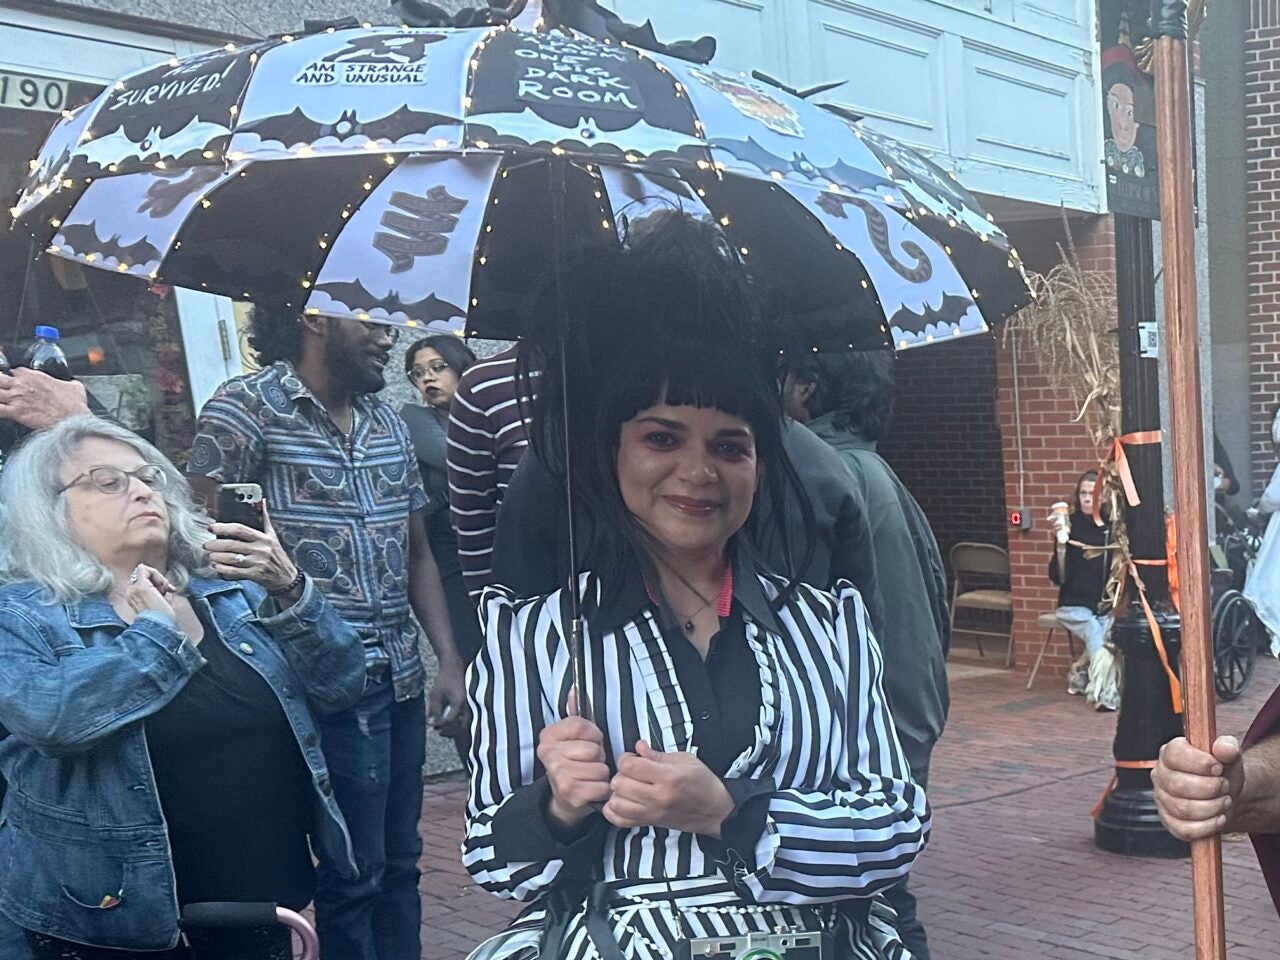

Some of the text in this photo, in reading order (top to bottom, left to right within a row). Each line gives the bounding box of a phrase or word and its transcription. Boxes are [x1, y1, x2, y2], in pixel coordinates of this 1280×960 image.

[514, 49, 591, 64] ONE
[305, 62, 427, 73] AM STRANGE
[552, 62, 611, 78] BIG
[109, 58, 238, 110] SURVIVED!
[296, 72, 423, 83] AND UNUSUAL
[524, 66, 631, 89] DARK
[0, 76, 63, 110] 190
[518, 79, 638, 109] ROOM
